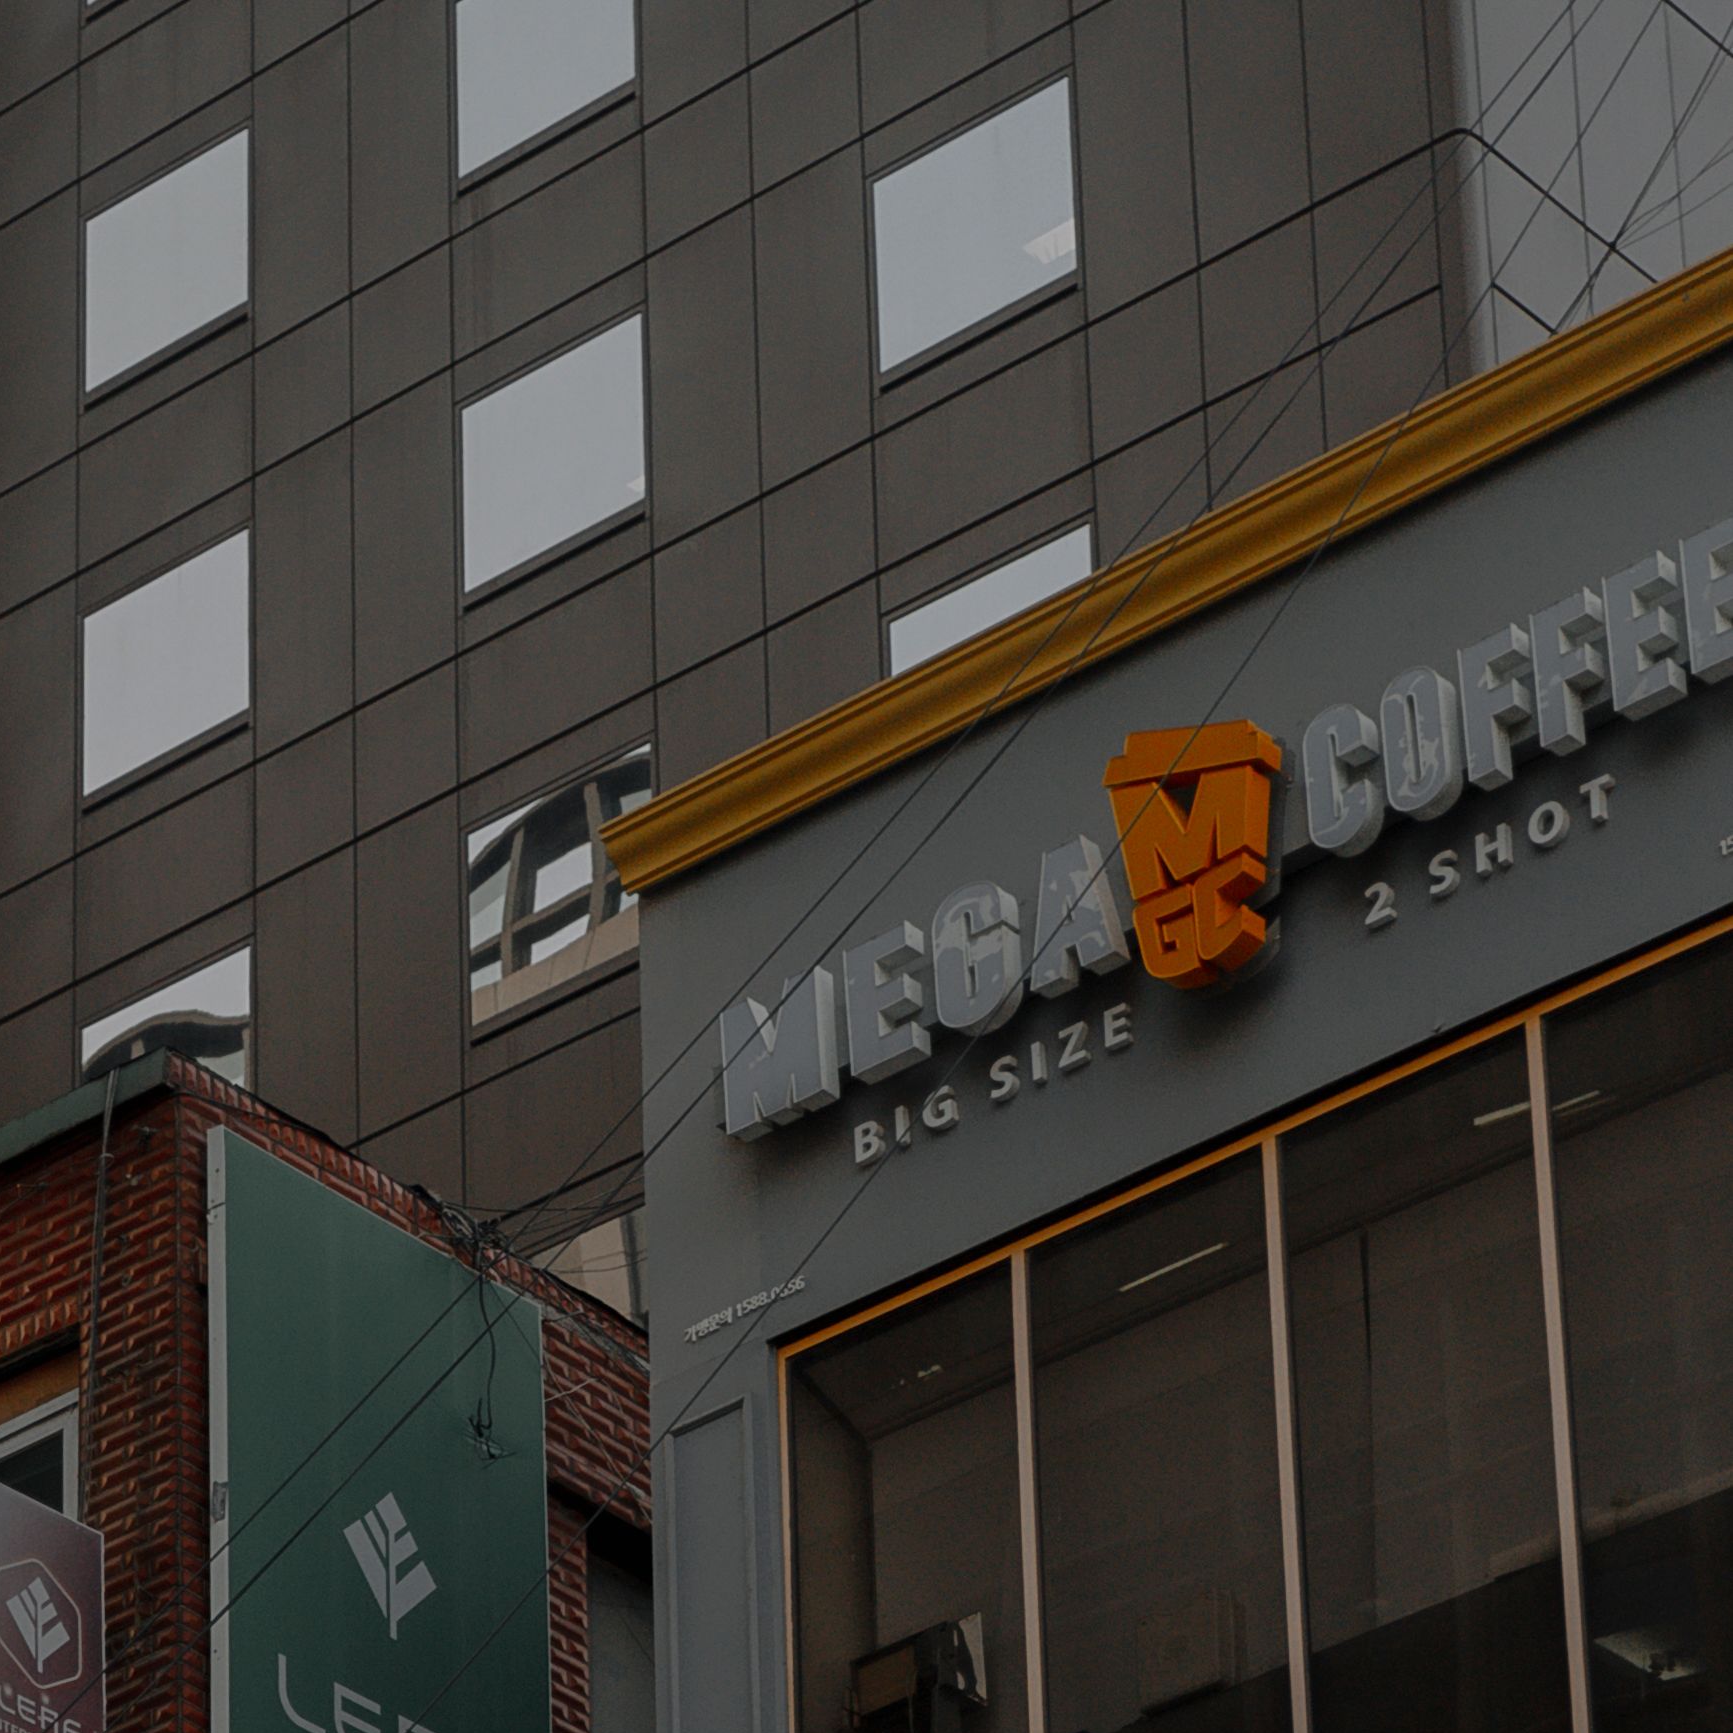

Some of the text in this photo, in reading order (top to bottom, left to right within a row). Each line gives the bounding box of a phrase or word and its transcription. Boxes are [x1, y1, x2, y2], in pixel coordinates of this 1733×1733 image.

[719, 834, 1132, 1141] MEGA
[1302, 518, 1733, 856] COFFEE
[1364, 773, 1616, 929] 2 SHOT
[853, 1003, 1134, 1166] BIG SIZE
